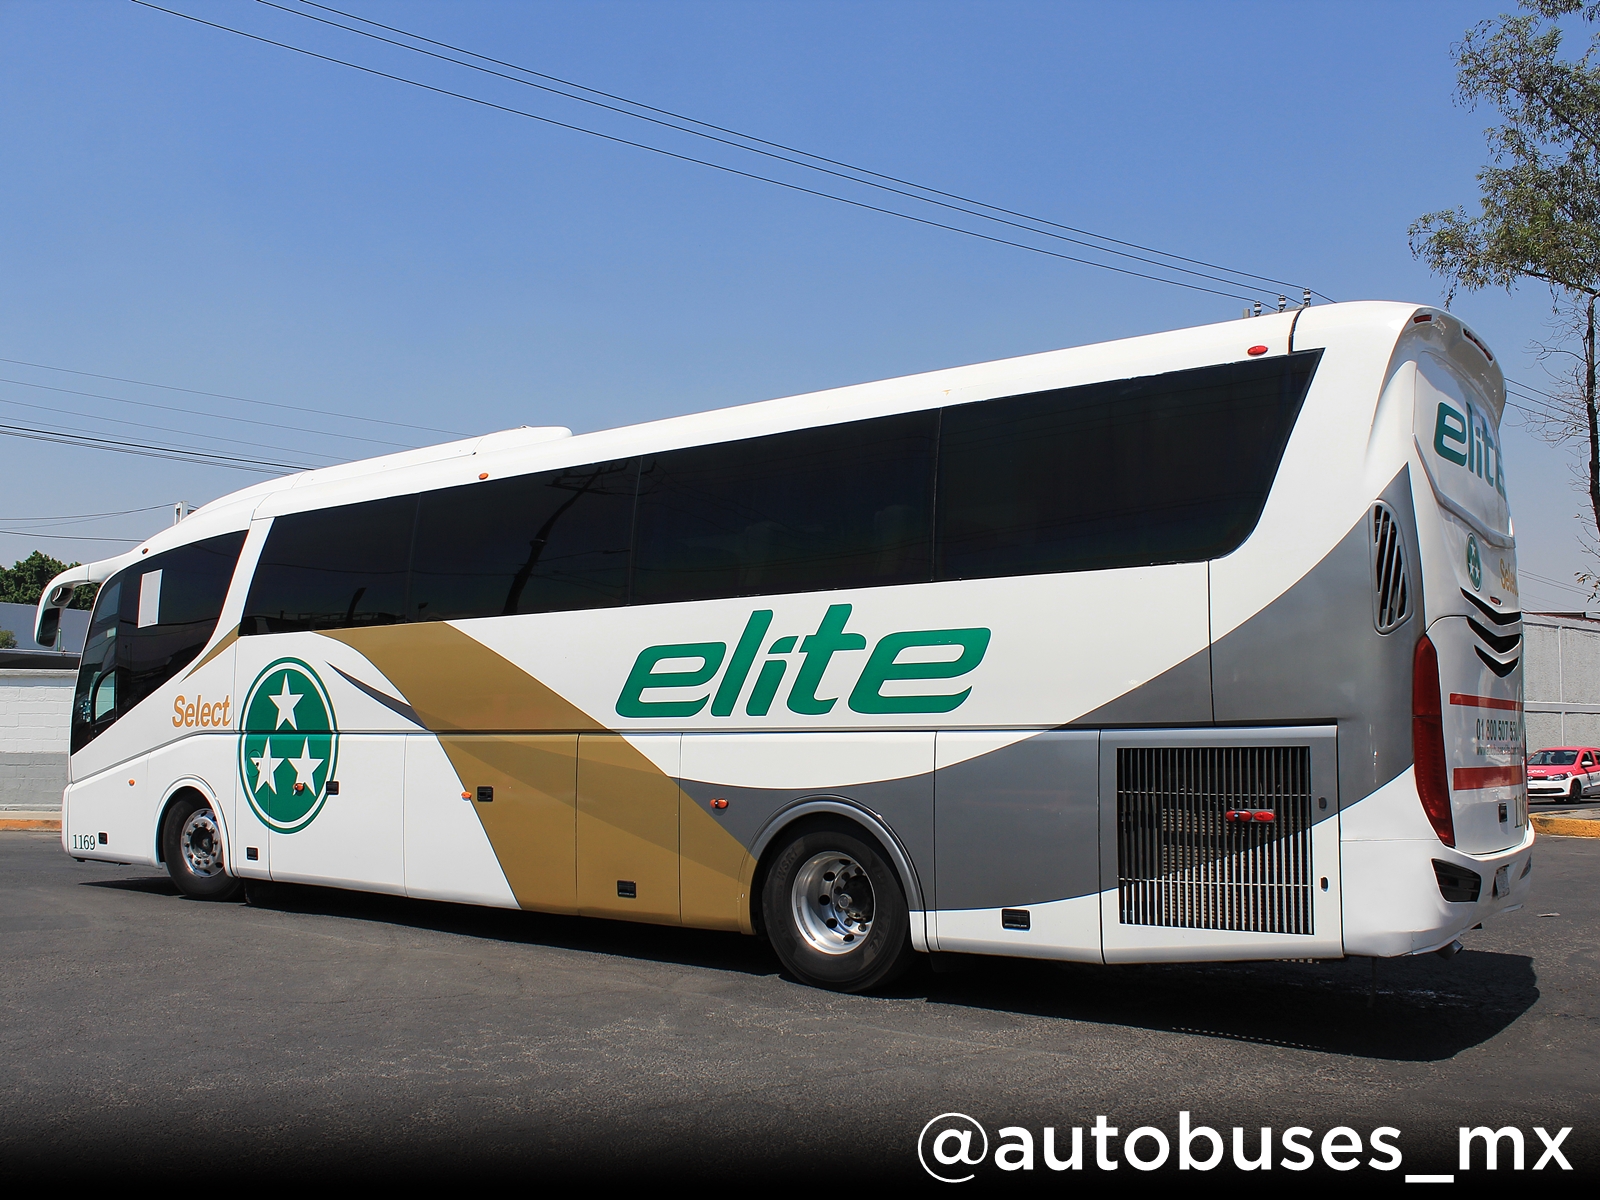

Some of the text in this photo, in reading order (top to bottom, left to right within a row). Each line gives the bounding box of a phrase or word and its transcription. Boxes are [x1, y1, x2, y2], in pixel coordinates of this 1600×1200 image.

[614, 603, 992, 718] elite
[171, 694, 233, 728] Select
[72, 833, 96, 851] 1169
